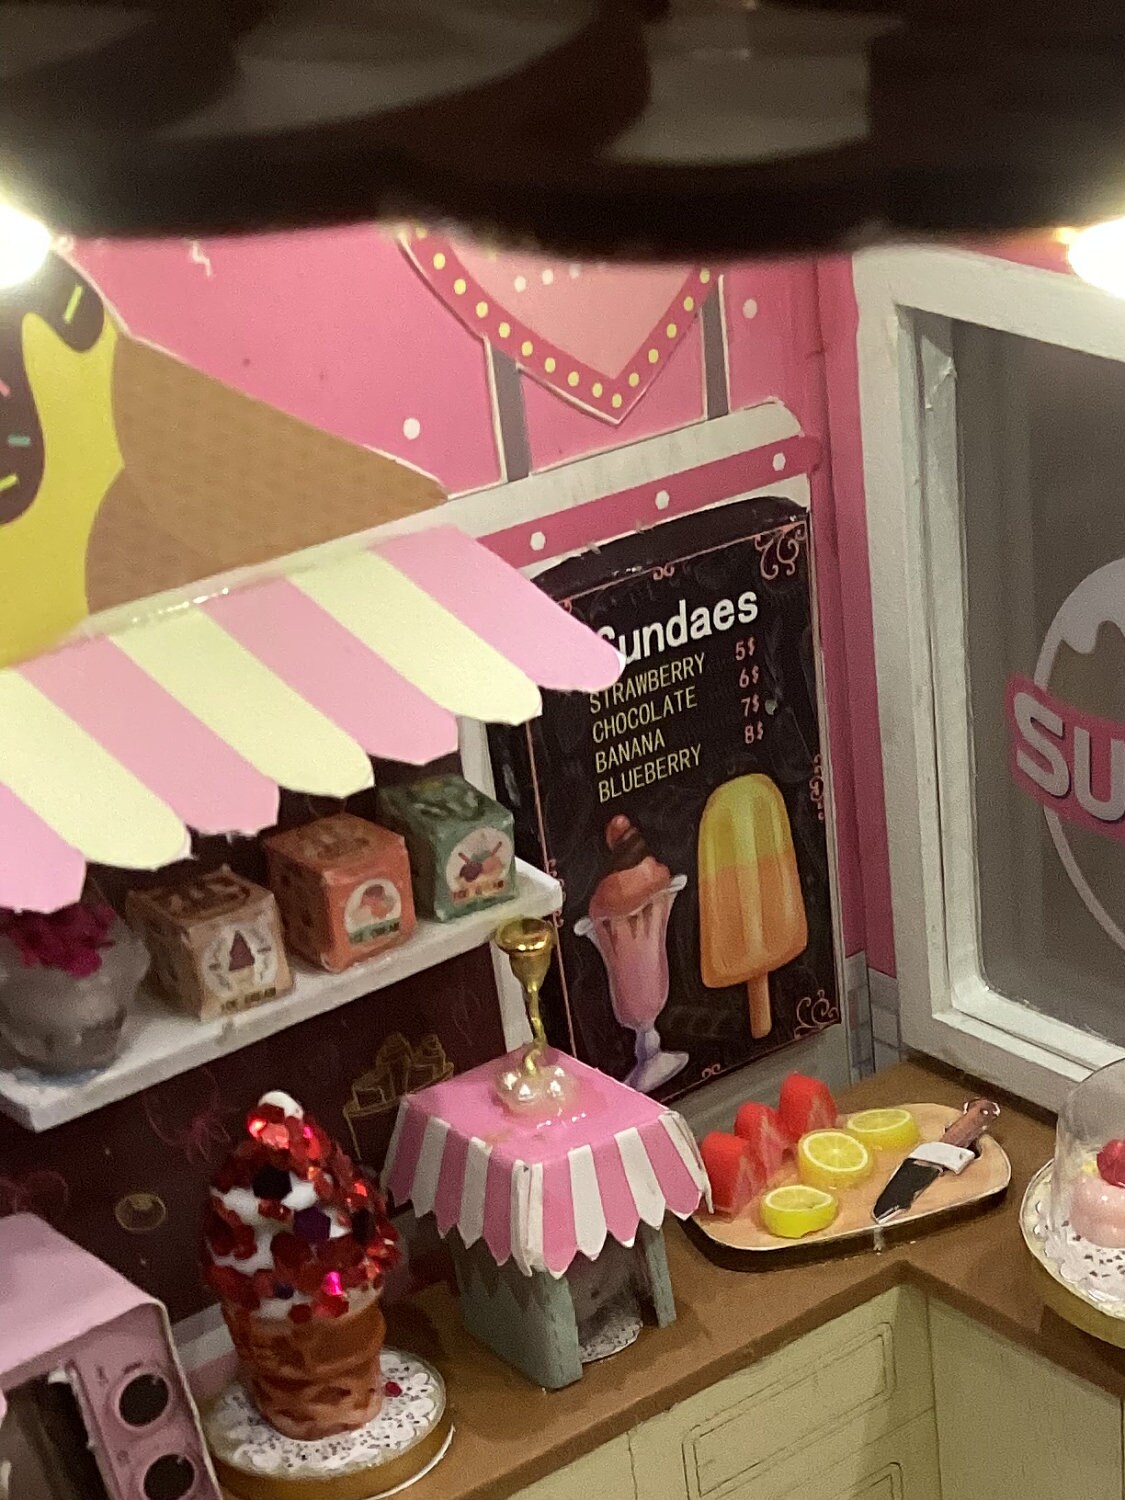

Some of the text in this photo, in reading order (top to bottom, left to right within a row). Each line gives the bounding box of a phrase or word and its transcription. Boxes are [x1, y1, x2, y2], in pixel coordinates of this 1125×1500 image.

[590, 636, 756, 714] STRAWBERRY 5$
[592, 665, 759, 744] CHOCOLATE 6$
[595, 694, 760, 773] BANANA 7$
[598, 720, 764, 803] BLUEBERRY 8$
